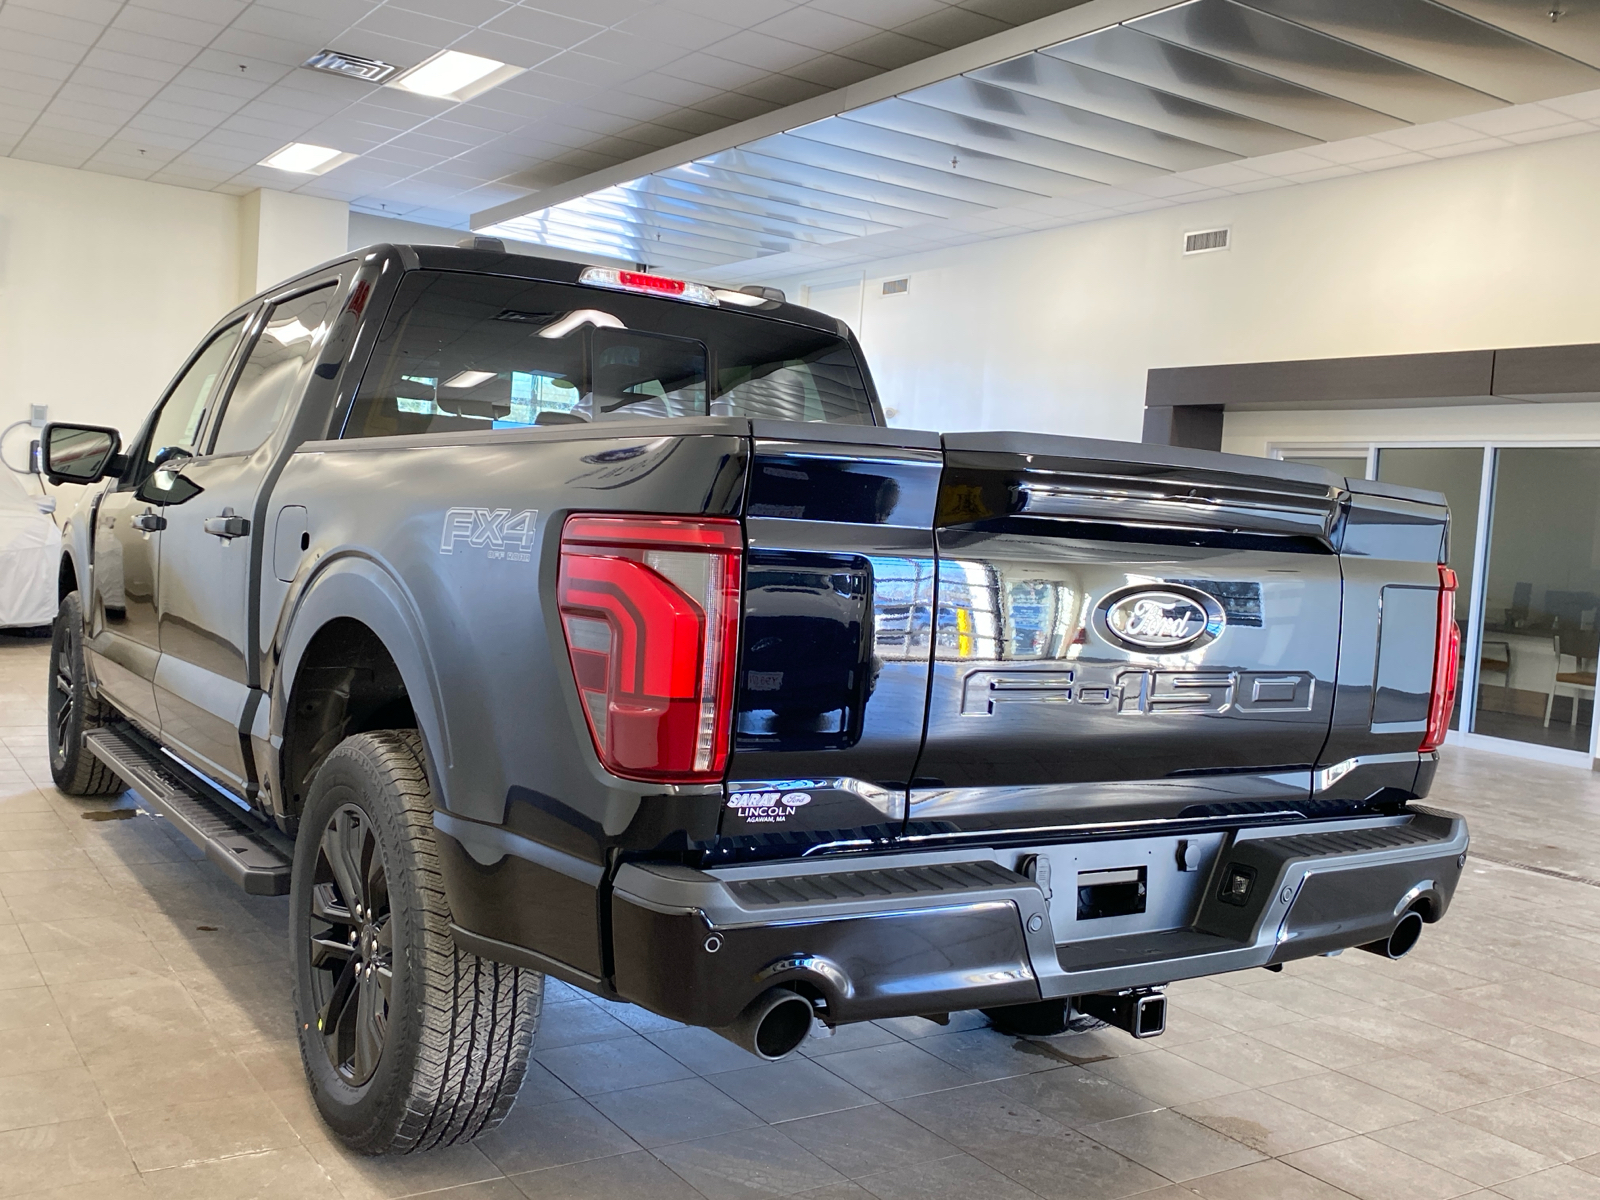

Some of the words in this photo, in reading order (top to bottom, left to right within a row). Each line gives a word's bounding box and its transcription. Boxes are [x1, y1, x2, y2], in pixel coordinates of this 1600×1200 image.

[440, 506, 539, 555] FX4
[1126, 599, 1192, 638] Ford
[960, 669, 1317, 717] F-150
[727, 792, 781, 808] SARAT
[737, 806, 796, 817] LINCOLN
